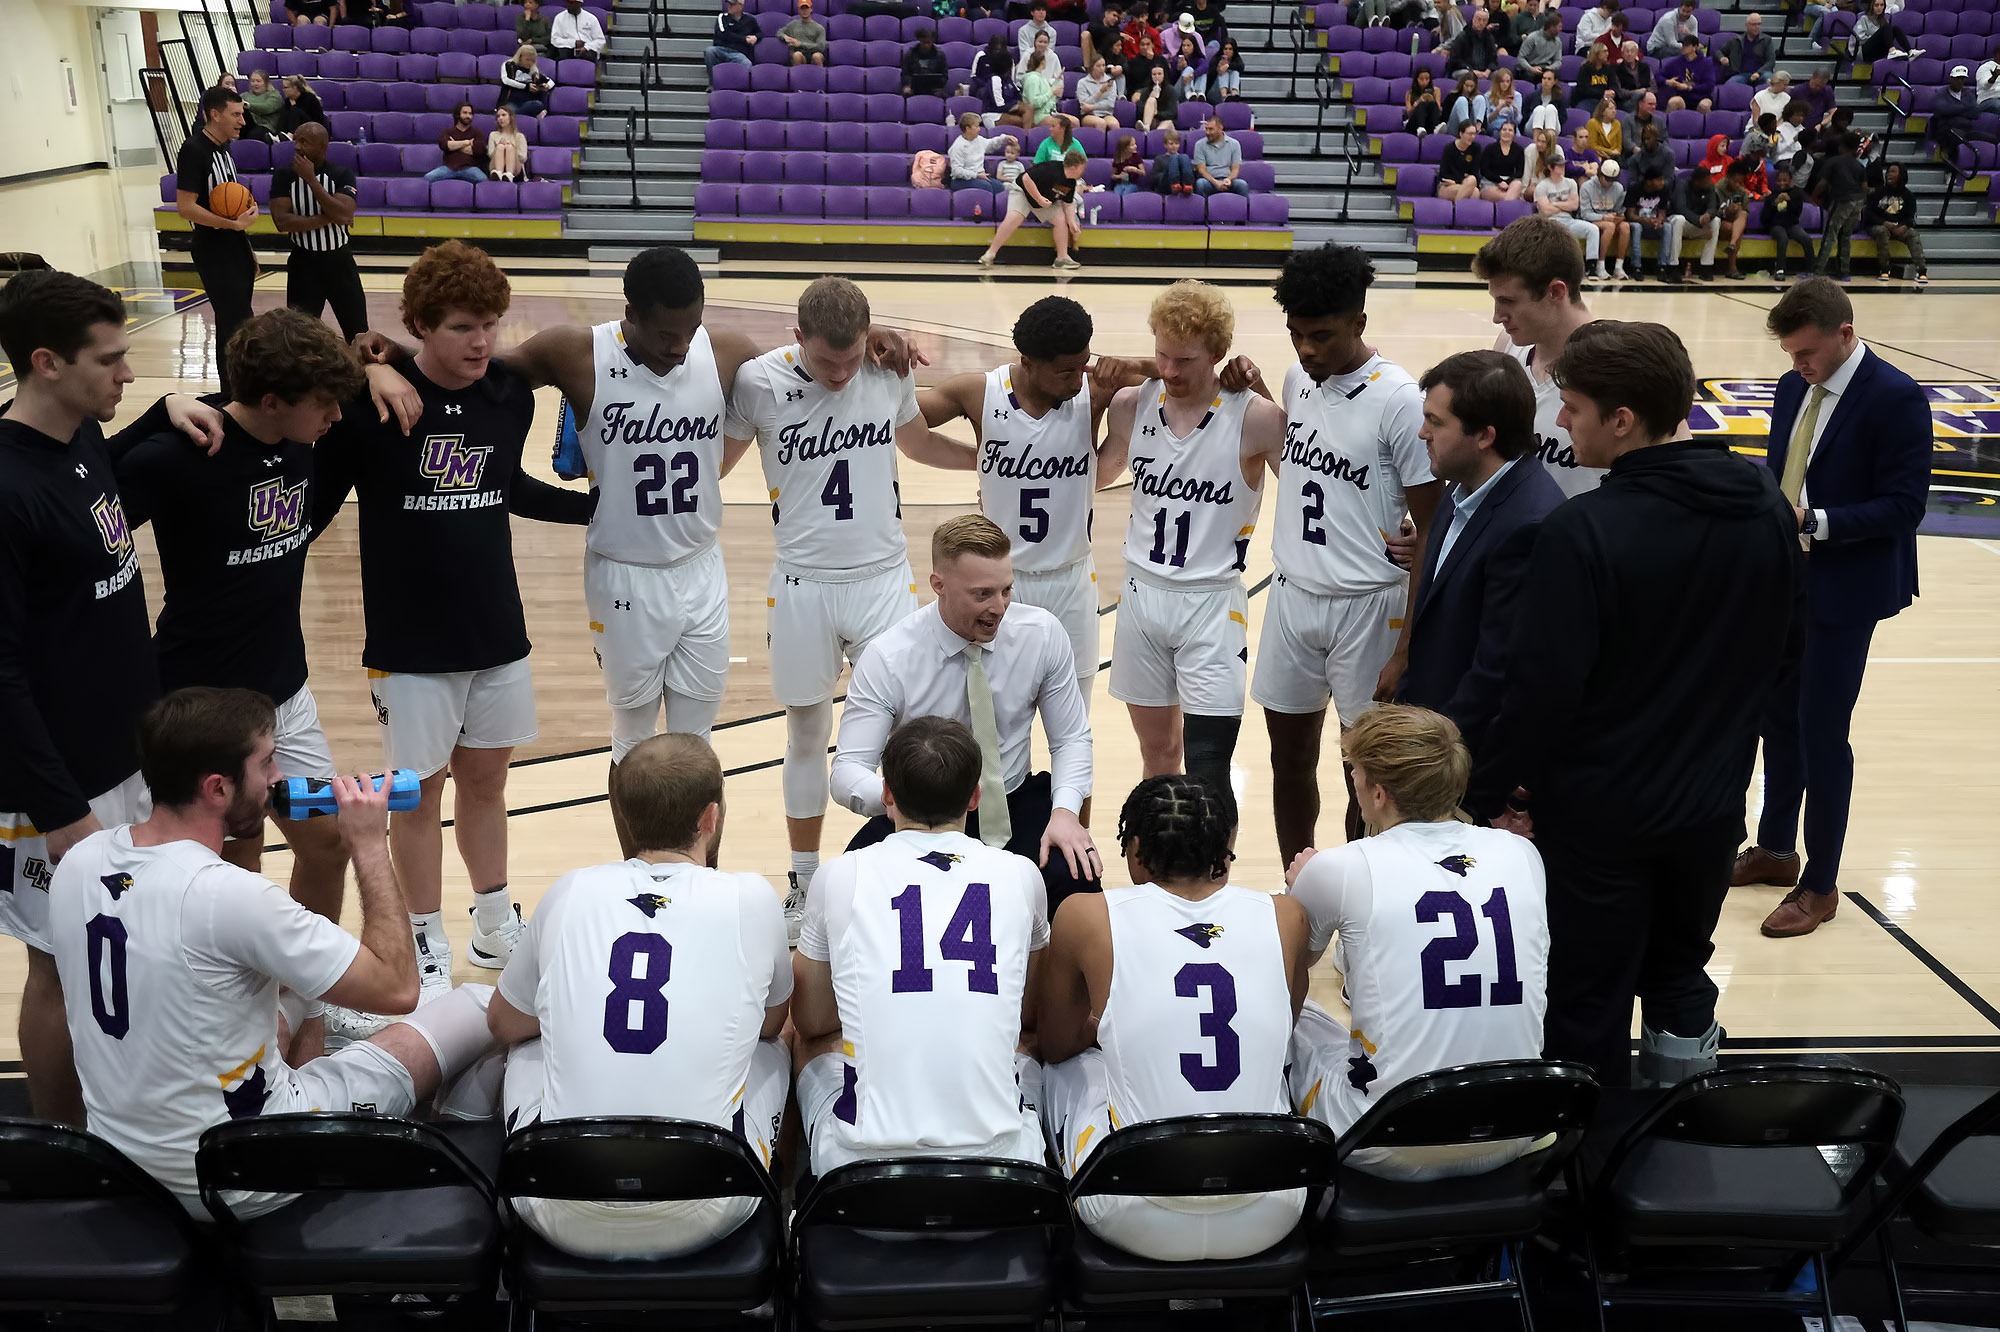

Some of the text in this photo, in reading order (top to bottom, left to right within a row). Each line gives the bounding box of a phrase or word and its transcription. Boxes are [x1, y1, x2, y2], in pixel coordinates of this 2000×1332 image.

[600, 401, 720, 446] Falcons
[777, 416, 893, 466] Falcons
[422, 437, 485, 489] UM
[633, 450, 699, 517] 22
[981, 439, 1090, 481] Falcons
[1132, 456, 1234, 506] Falcons
[1281, 421, 1370, 491] Falcons
[251, 479, 303, 539] UM
[403, 489, 503, 511] BASKETBALL
[820, 459, 854, 521] 4
[1018, 487, 1050, 544] 5
[1301, 479, 1327, 546] 2
[1148, 507, 1191, 569] 11
[890, 882, 999, 996] 14
[1414, 886, 1523, 1010] 21
[85, 912, 130, 1041] 0
[602, 931, 673, 1055] 8
[1173, 962, 1241, 1092] 3
